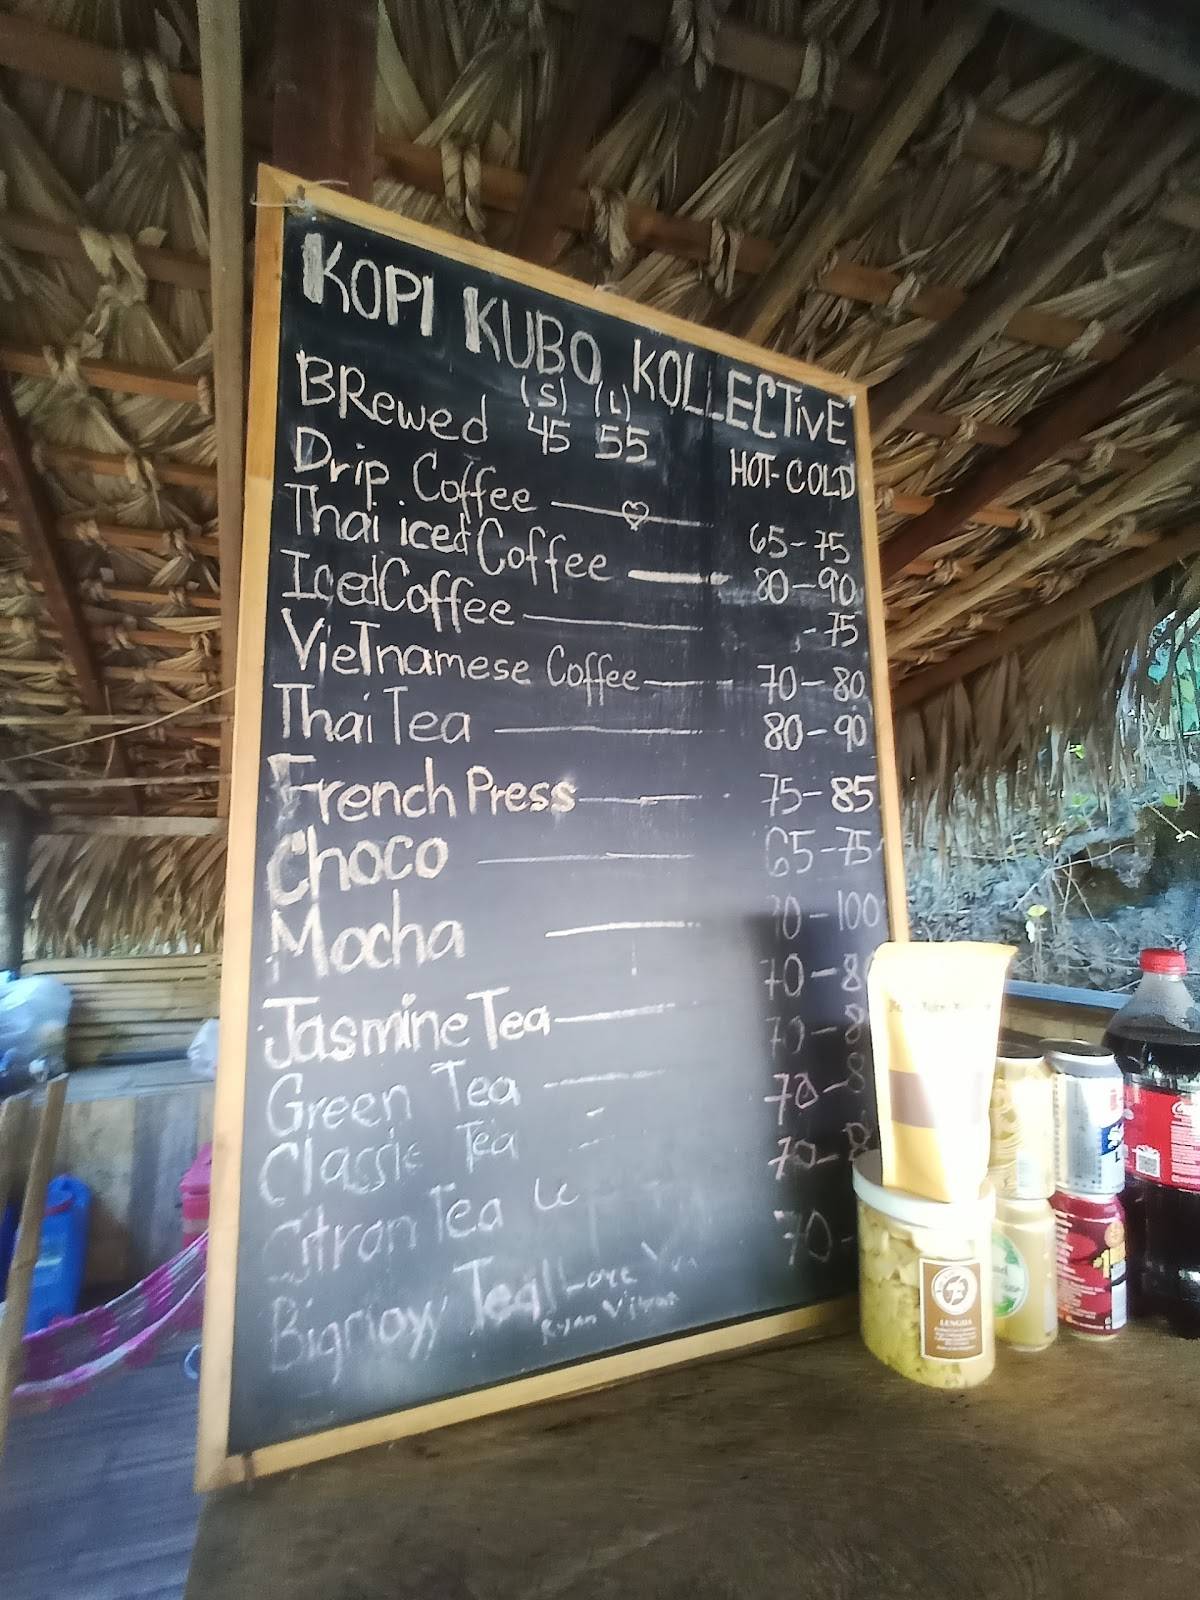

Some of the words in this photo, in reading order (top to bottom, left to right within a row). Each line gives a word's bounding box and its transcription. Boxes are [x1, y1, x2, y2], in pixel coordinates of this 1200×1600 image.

[302, 233, 434, 336] KOPI
[463, 286, 601, 385] KUBO
[294, 426, 391, 512] Drip
[413, 450, 537, 523] Coffee
[528, 411, 571, 455] 45
[594, 424, 650, 463] 55
[284, 482, 380, 544] Thai
[476, 517, 614, 593] Coffee
[273, 683, 373, 744] Thai
[383, 686, 472, 745] Tea
[546, 645, 641, 707] Coffee
[267, 752, 456, 830] French
[466, 765, 577, 815] Press
[266, 825, 449, 906] Choco
[265, 888, 466, 986] Mocha
[257, 993, 471, 1071] Jasmine
[466, 986, 551, 1051] Tea
[266, 1073, 412, 1137] Green
[430, 1059, 521, 1113] Tea
[455, 1119, 519, 1174] Tea
[429, 1182, 503, 1243] Tea
